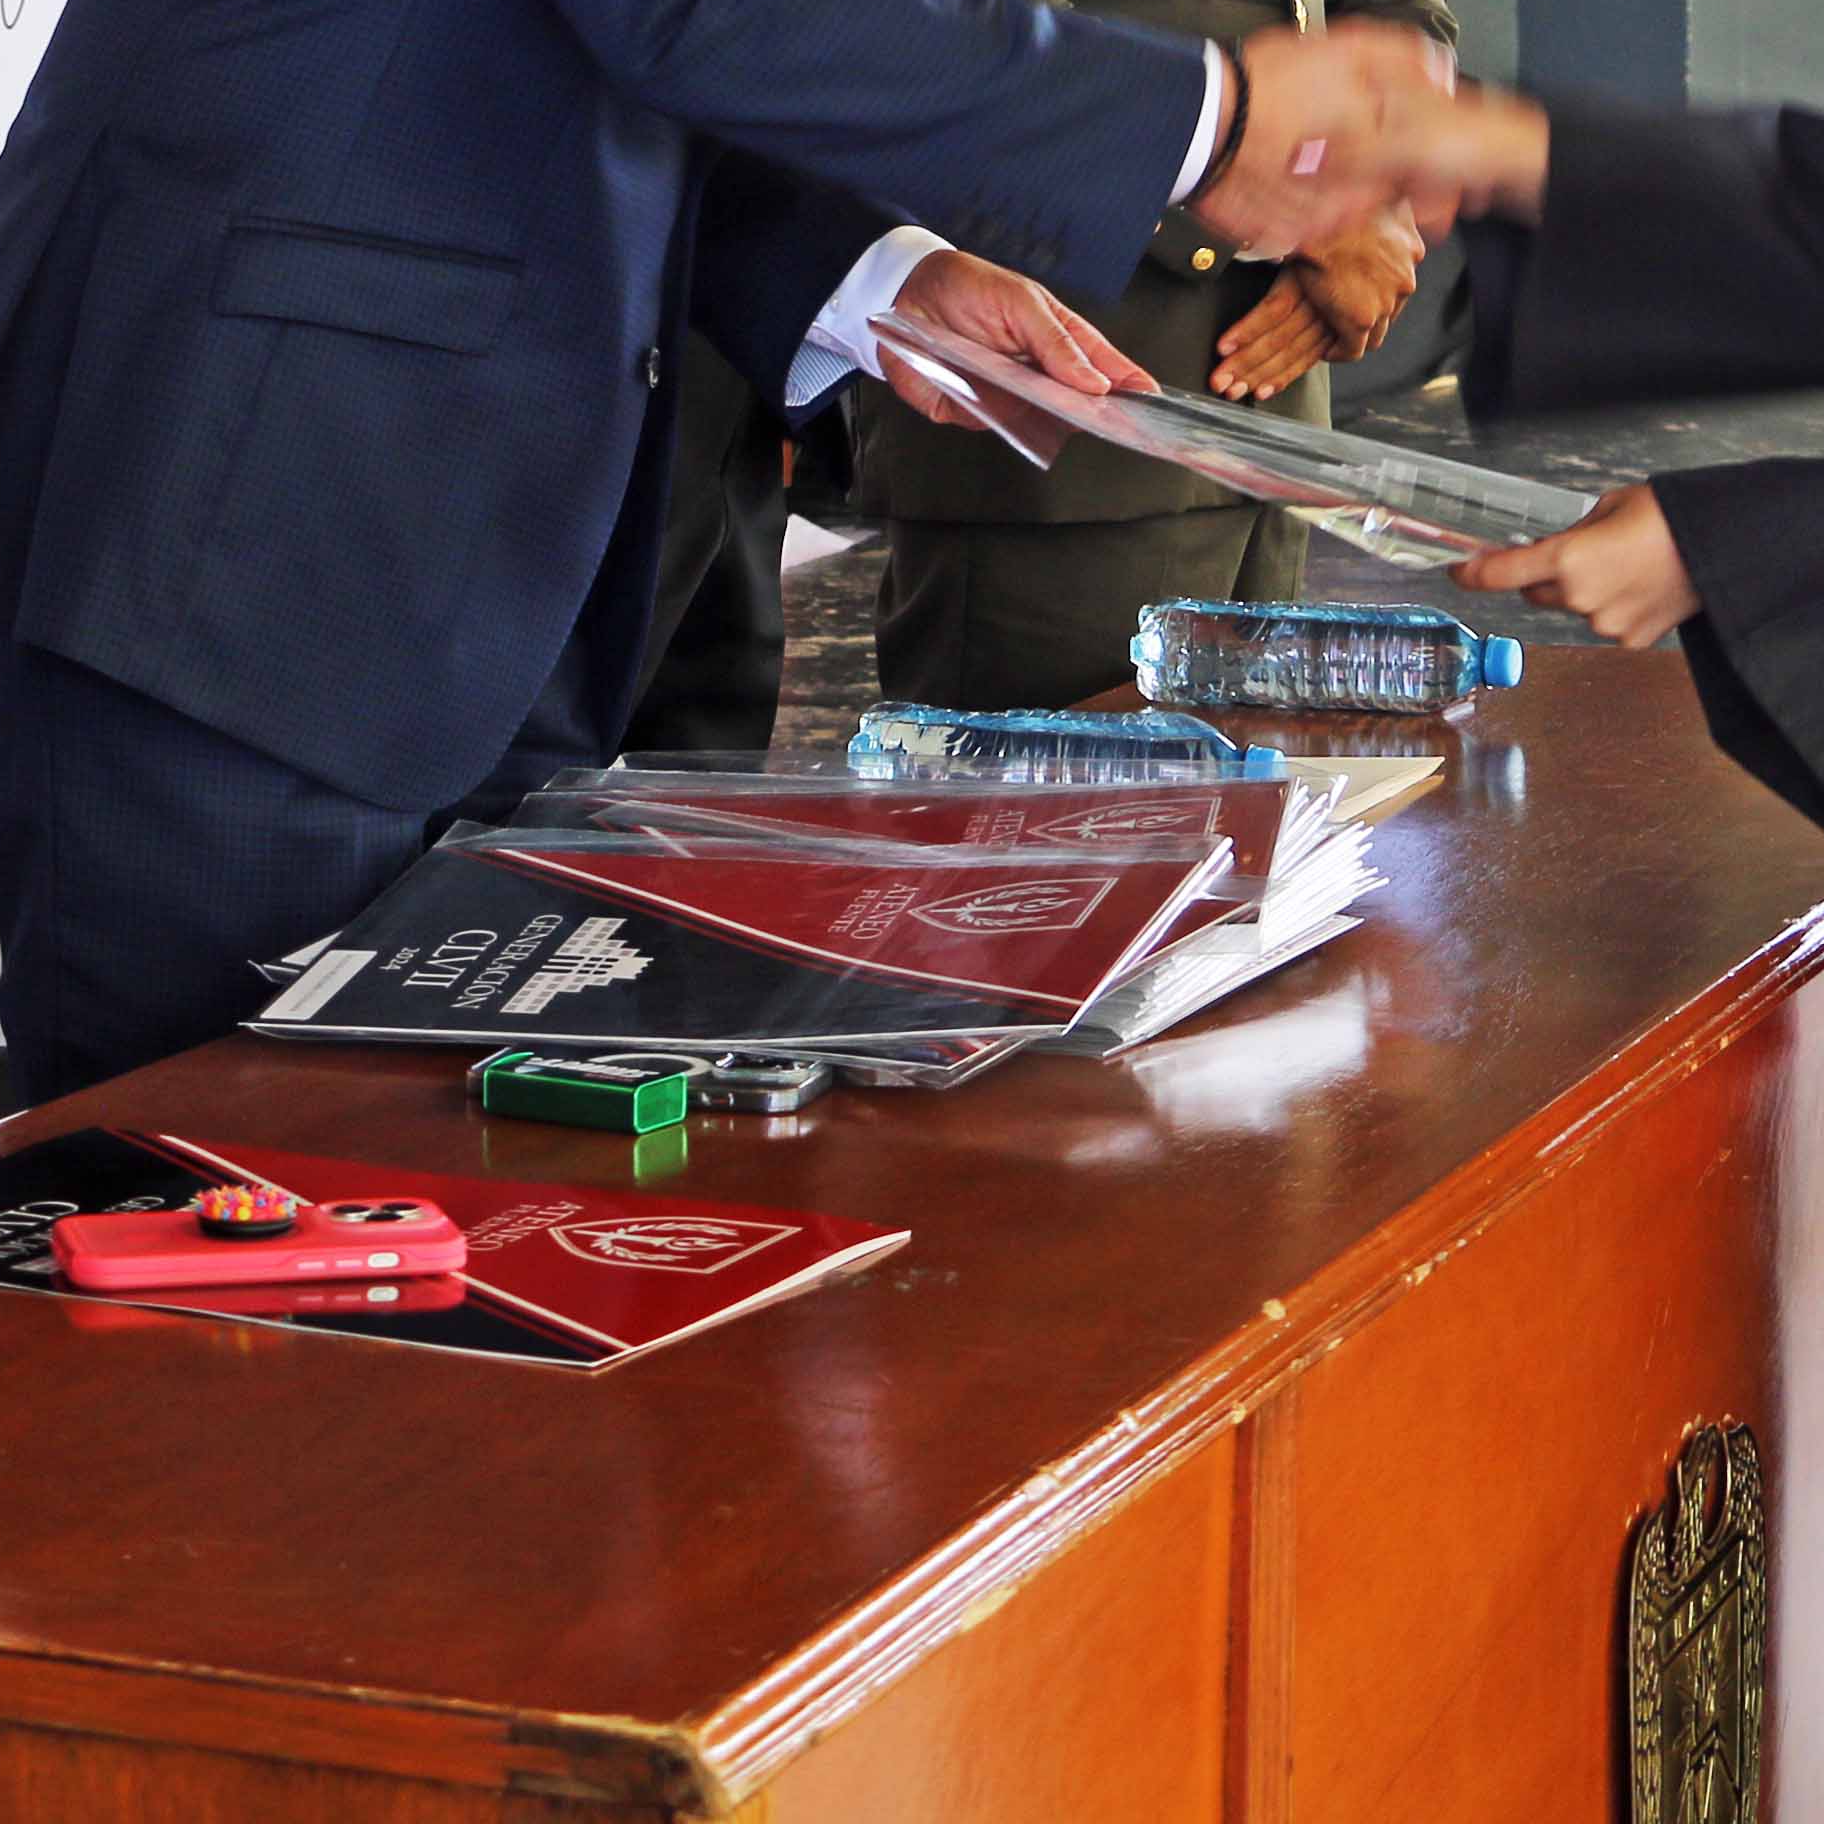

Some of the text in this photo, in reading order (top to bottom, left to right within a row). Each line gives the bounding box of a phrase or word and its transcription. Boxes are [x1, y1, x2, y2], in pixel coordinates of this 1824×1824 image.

[827, 888, 881, 935] FUENTE
[850, 882, 920, 941] ATENEO
[379, 946, 421, 971] 2024
[402, 928, 499, 989] CLVII
[450, 913, 564, 1010] GENERACIÓN
